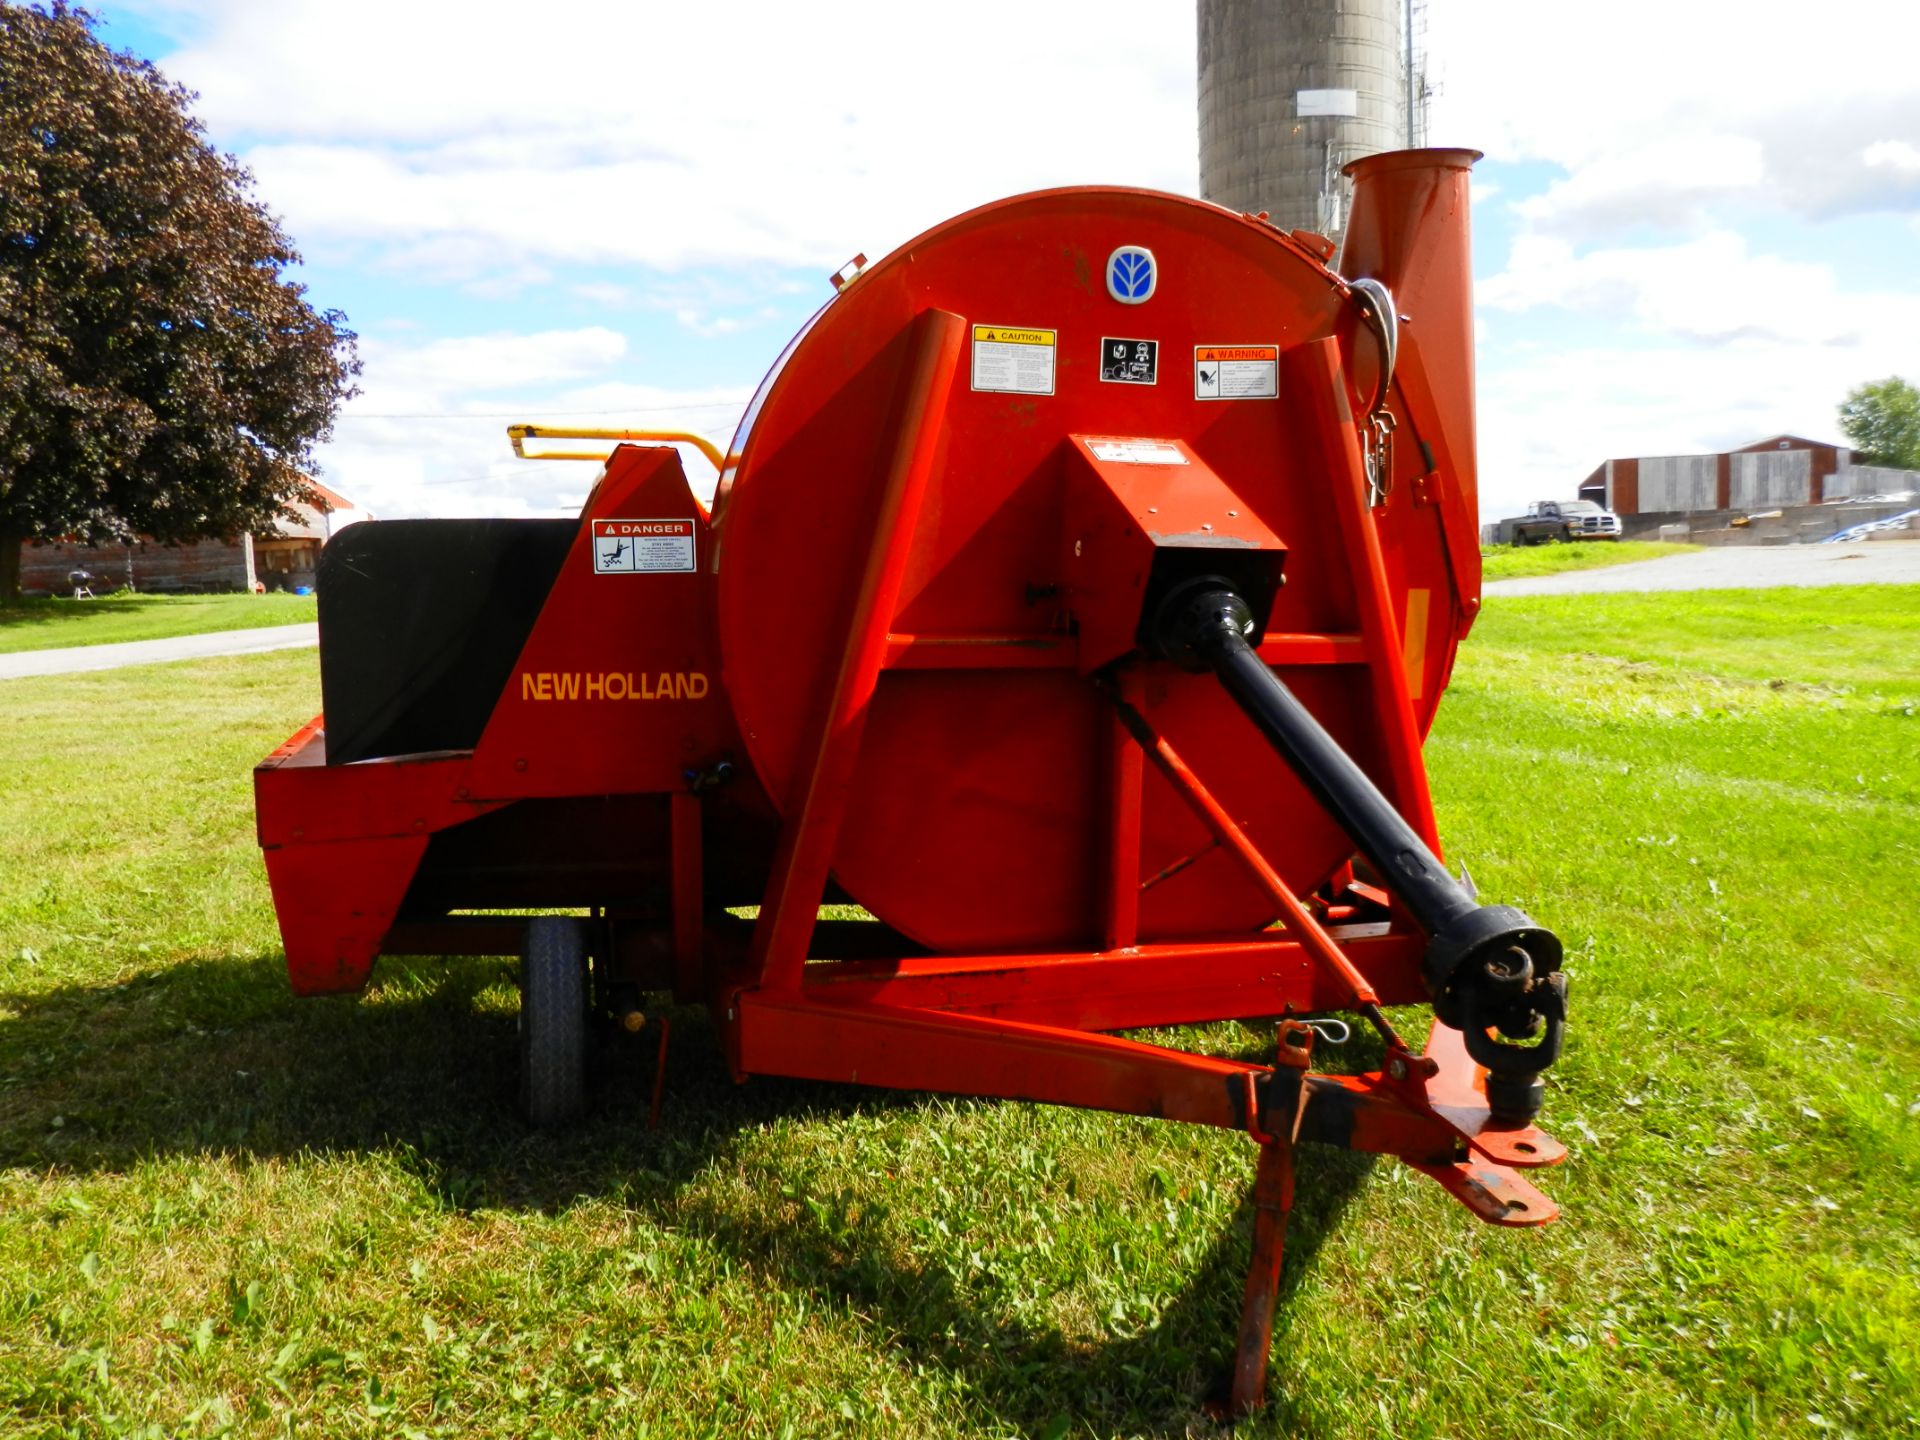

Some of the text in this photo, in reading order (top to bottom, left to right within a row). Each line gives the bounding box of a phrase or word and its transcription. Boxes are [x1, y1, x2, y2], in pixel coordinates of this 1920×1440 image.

[1001, 332, 1042, 342] CAUTION
[1217, 349, 1266, 359] WARNING
[621, 524, 684, 534] DANGER
[522, 672, 709, 700] NEW HOLLAND
